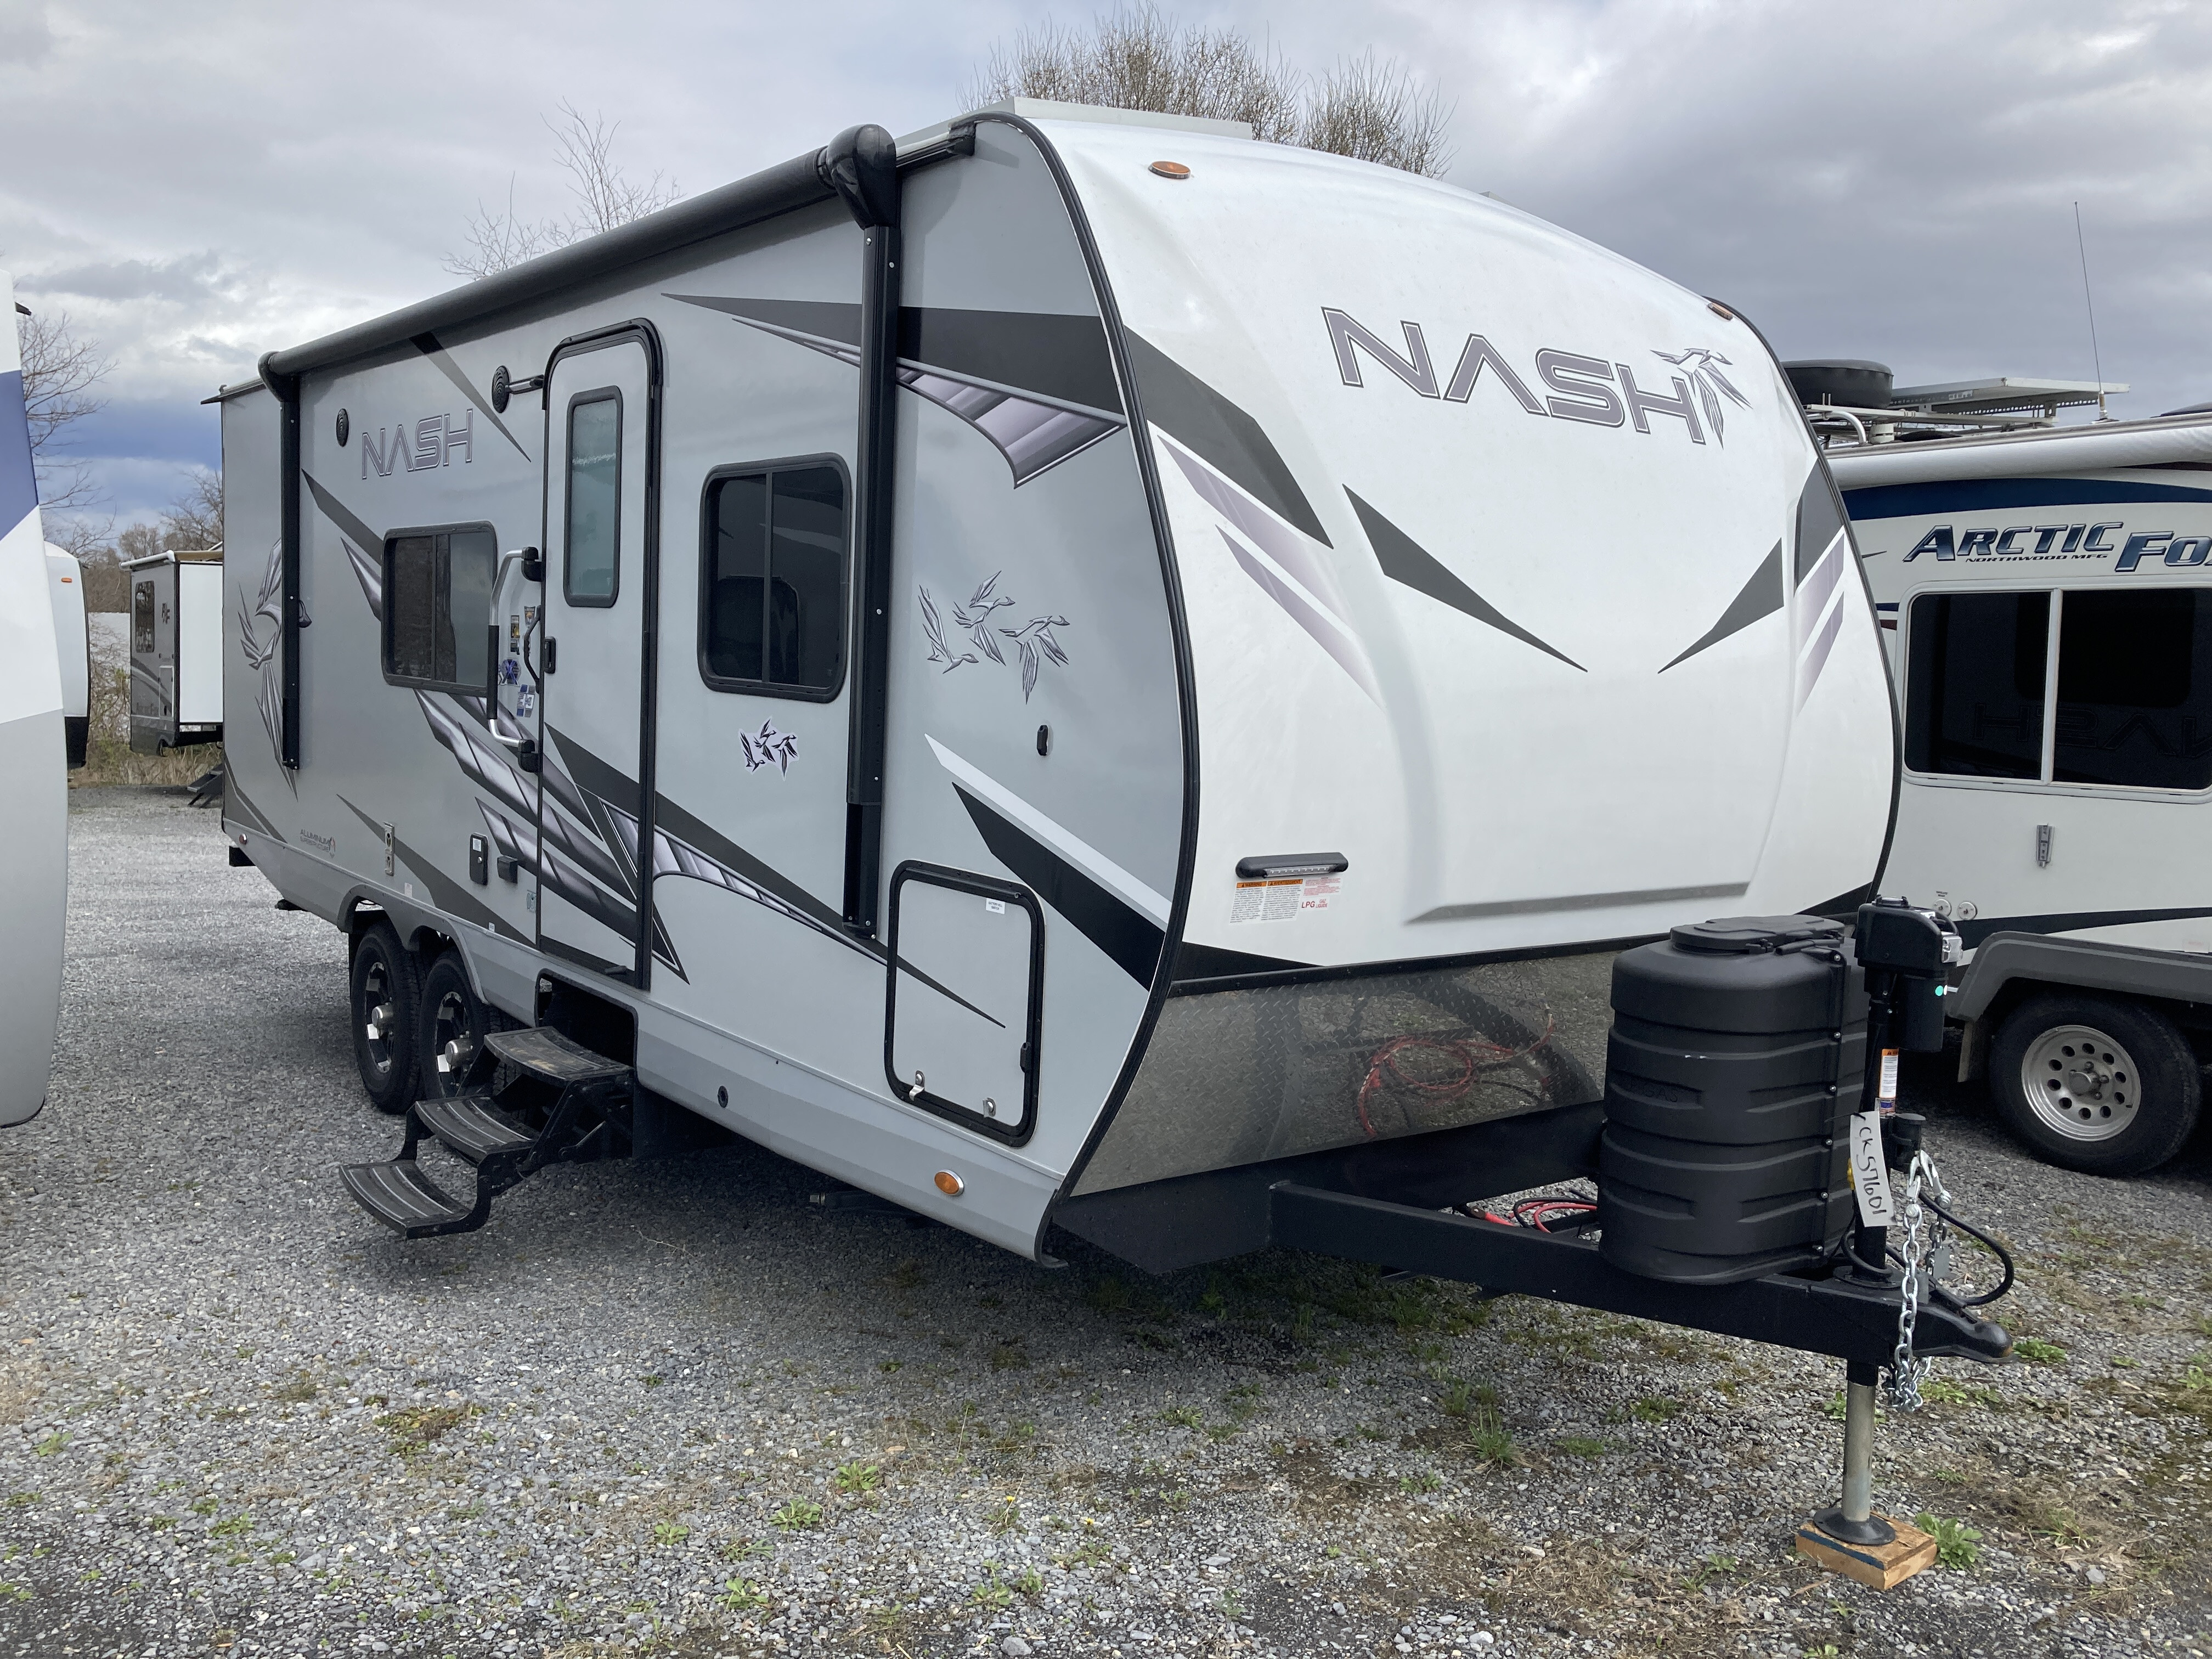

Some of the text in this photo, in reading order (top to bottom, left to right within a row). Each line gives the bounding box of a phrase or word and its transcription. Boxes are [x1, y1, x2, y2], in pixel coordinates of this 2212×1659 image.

[1321, 307, 1707, 445] NASH
[362, 408, 473, 480] NASH
[1903, 521, 2212, 573] ARCTIC FO
[1301, 900, 1316, 909] LPG
[1856, 1126, 1887, 1215] CK 57601
